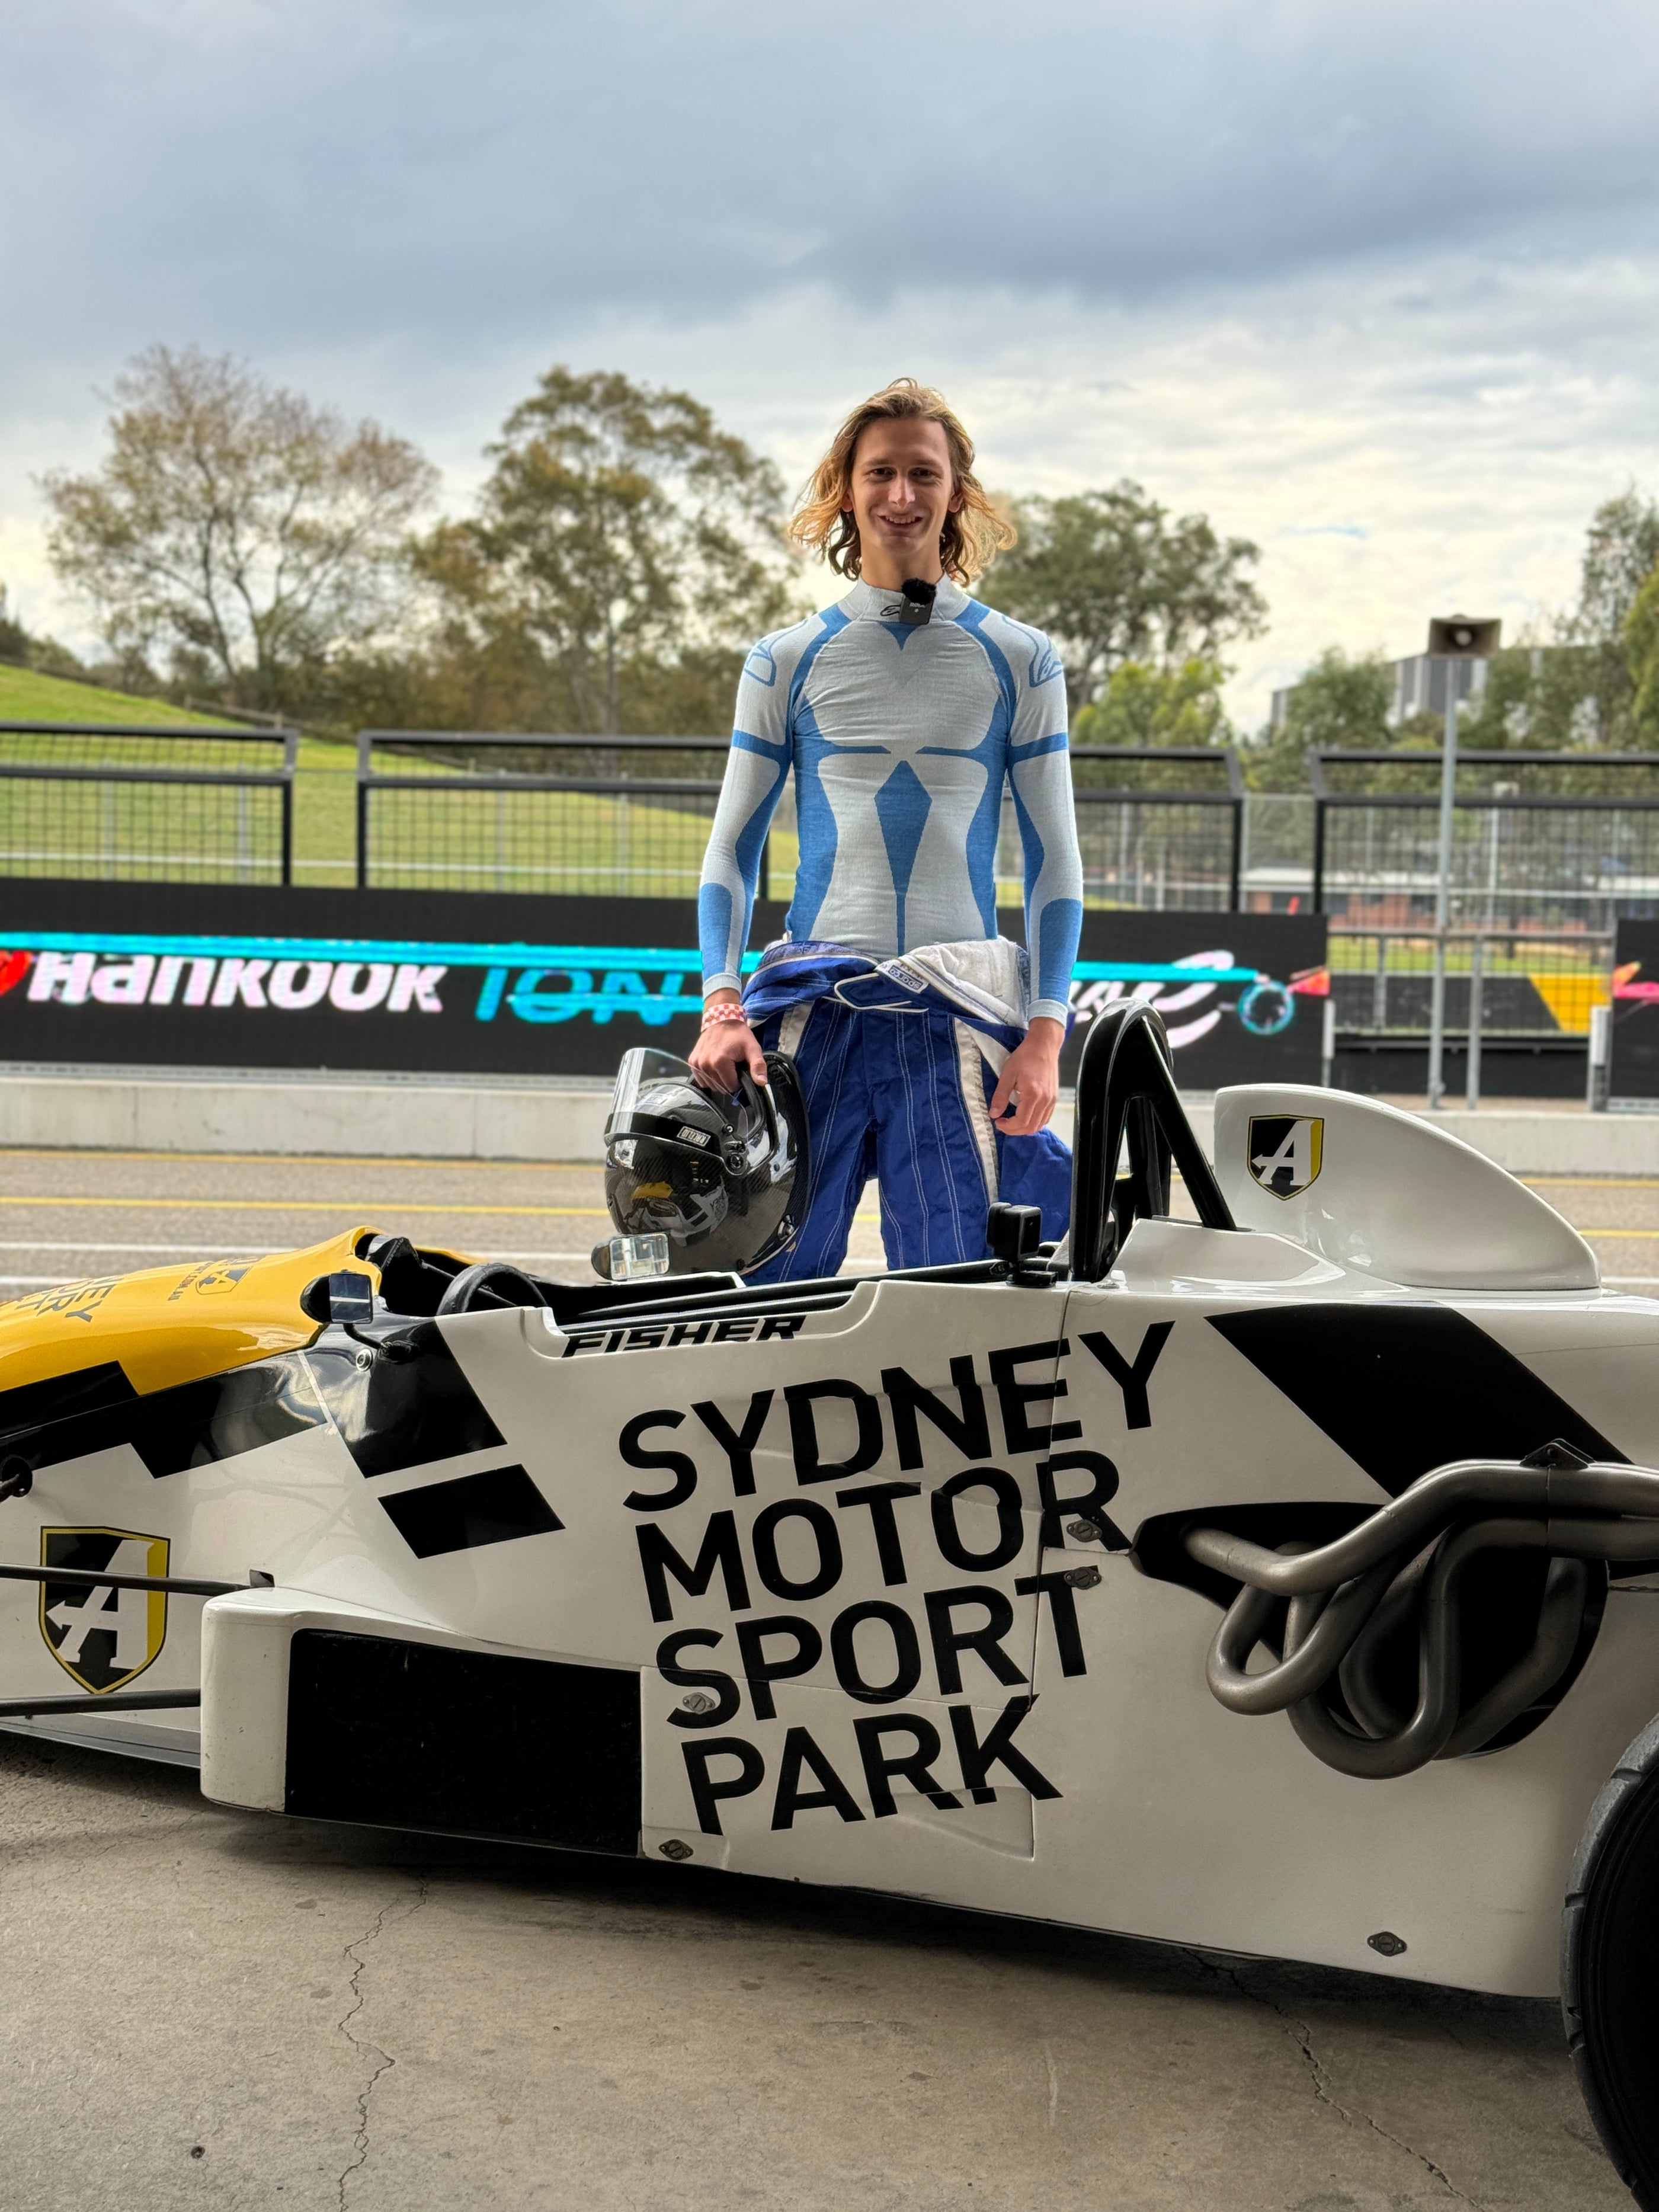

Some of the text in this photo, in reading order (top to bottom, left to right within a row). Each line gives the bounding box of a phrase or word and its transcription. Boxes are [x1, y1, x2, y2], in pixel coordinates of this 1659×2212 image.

[889, 968, 921, 990] sparco
[562, 1315, 806, 1358] FISHER
[619, 1320, 1176, 1512] SYDNEY
[636, 1450, 1132, 1624] MOTOR
[656, 1565, 1100, 1729] SPORT
[681, 1694, 1064, 1836] PARK
